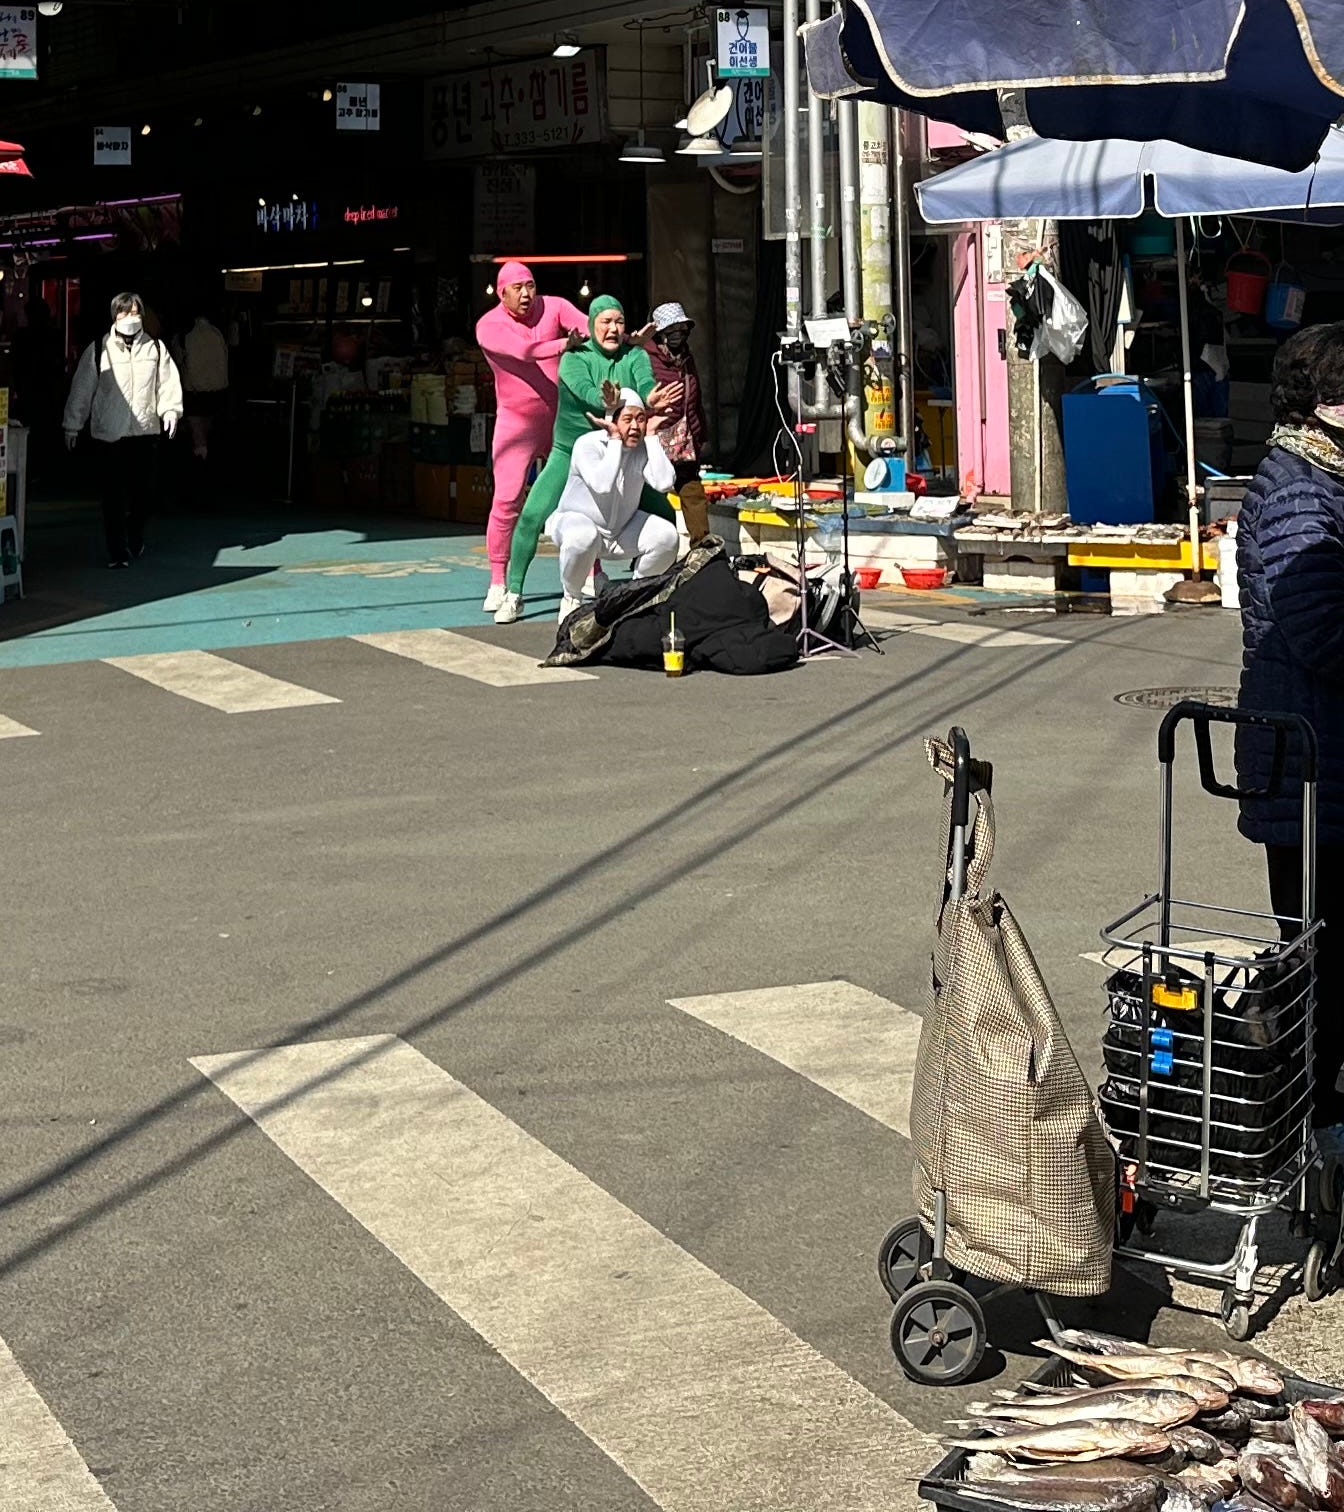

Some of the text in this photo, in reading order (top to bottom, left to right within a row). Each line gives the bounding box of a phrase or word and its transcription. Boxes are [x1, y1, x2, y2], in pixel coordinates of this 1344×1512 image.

[20, 9, 35, 21] 89
[718, 11, 730, 22] 88
[729, 42, 758, 55] 건어물
[729, 55, 758, 68] 이선생
